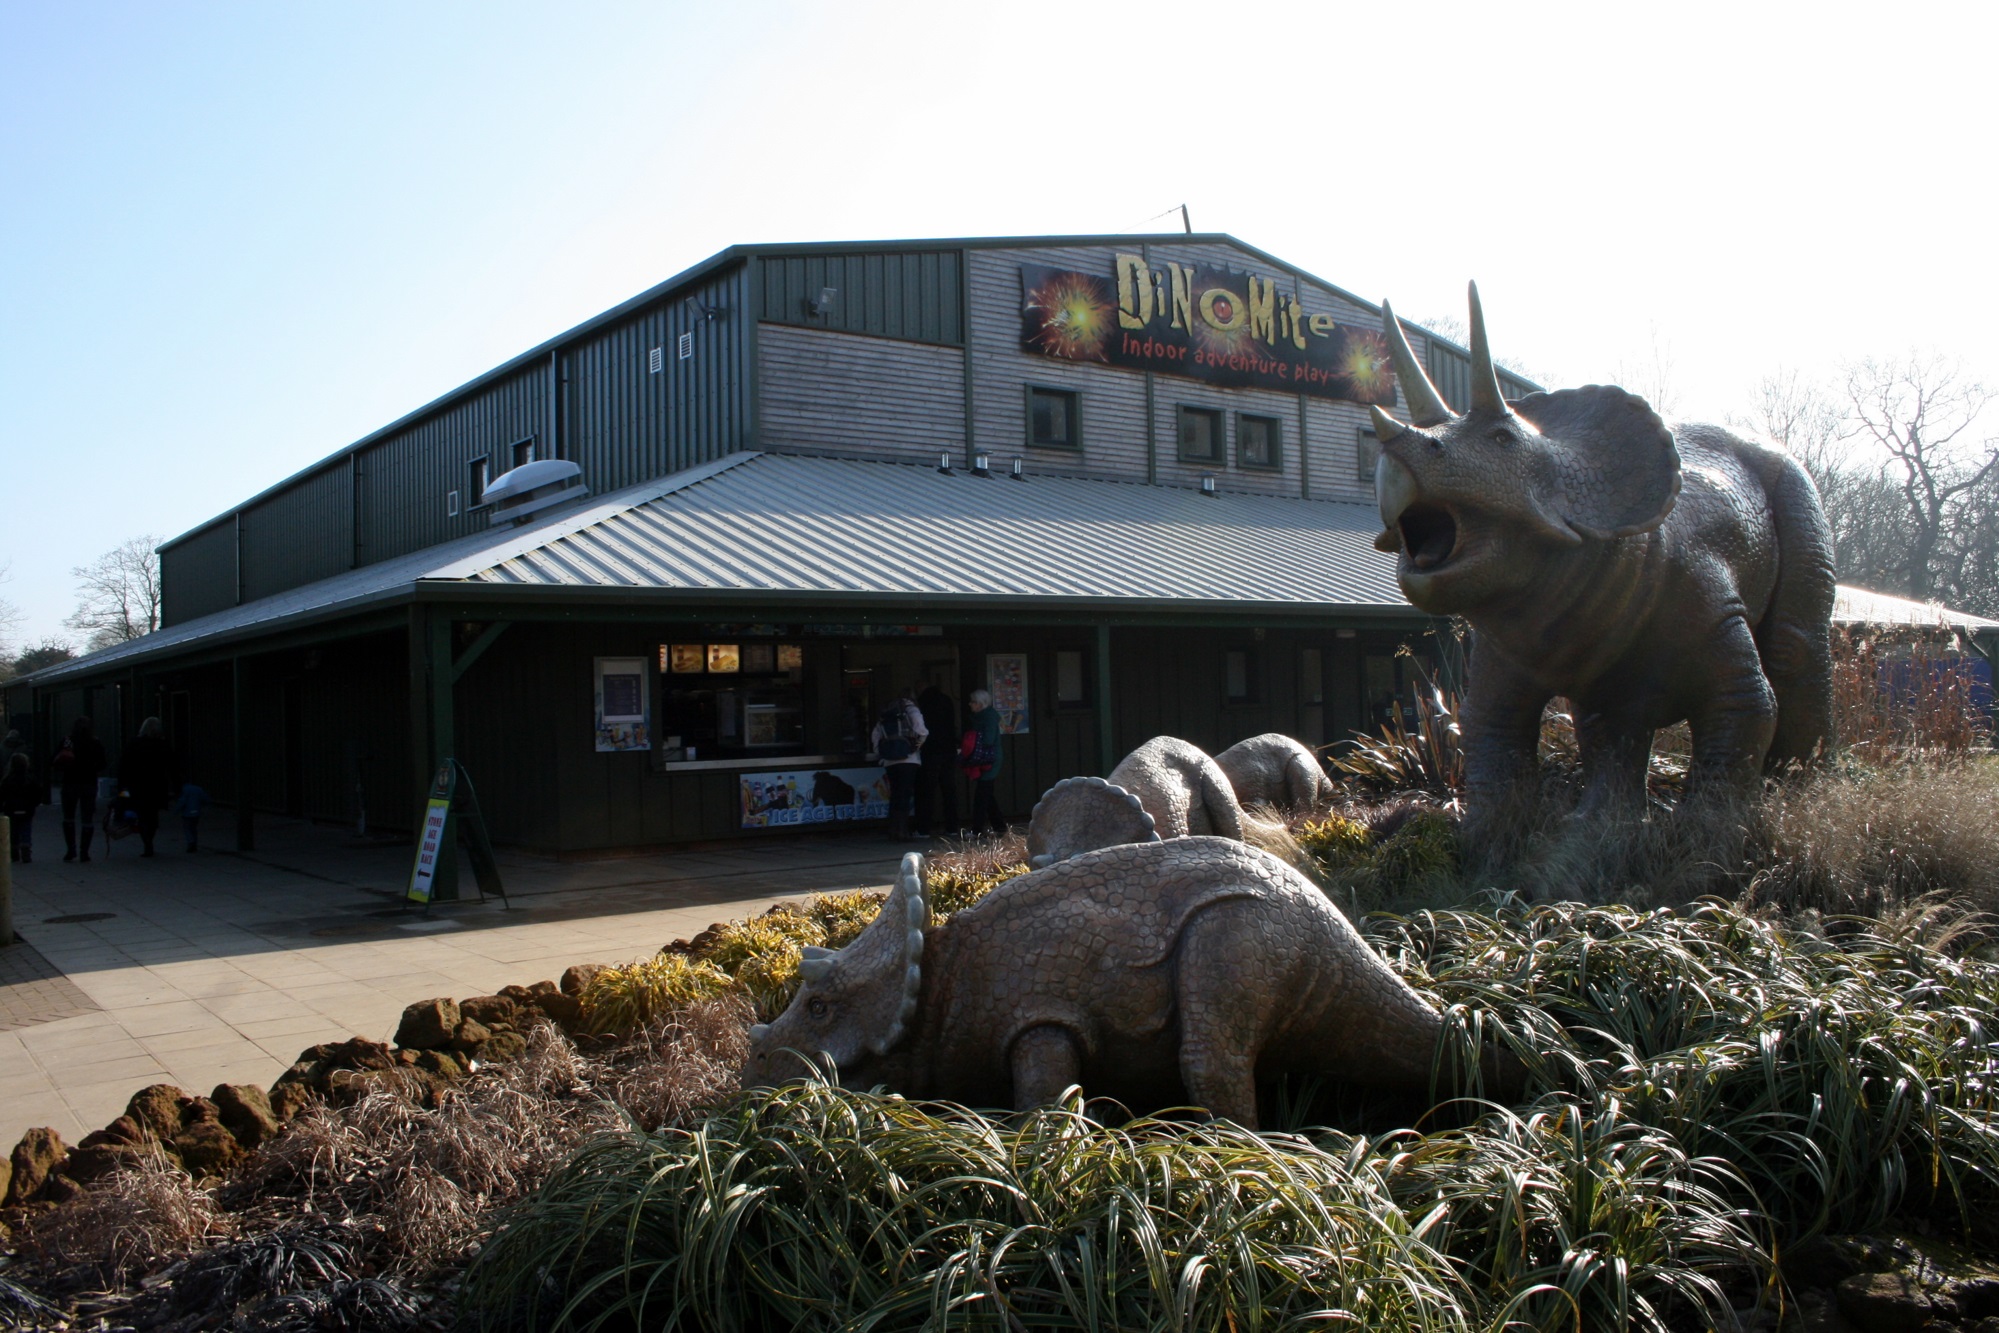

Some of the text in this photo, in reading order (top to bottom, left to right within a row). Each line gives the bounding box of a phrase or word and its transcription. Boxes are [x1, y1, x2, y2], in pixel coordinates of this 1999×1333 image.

[1122, 333, 1329, 386] Indoor adventure play
[774, 808, 799, 824] ICE
[801, 806, 834, 822] AGE
[428, 817, 442, 828] STONE
[428, 830, 437, 839] AGE
[423, 841, 436, 852] ROAD
[421, 854, 433, 865] RACE
